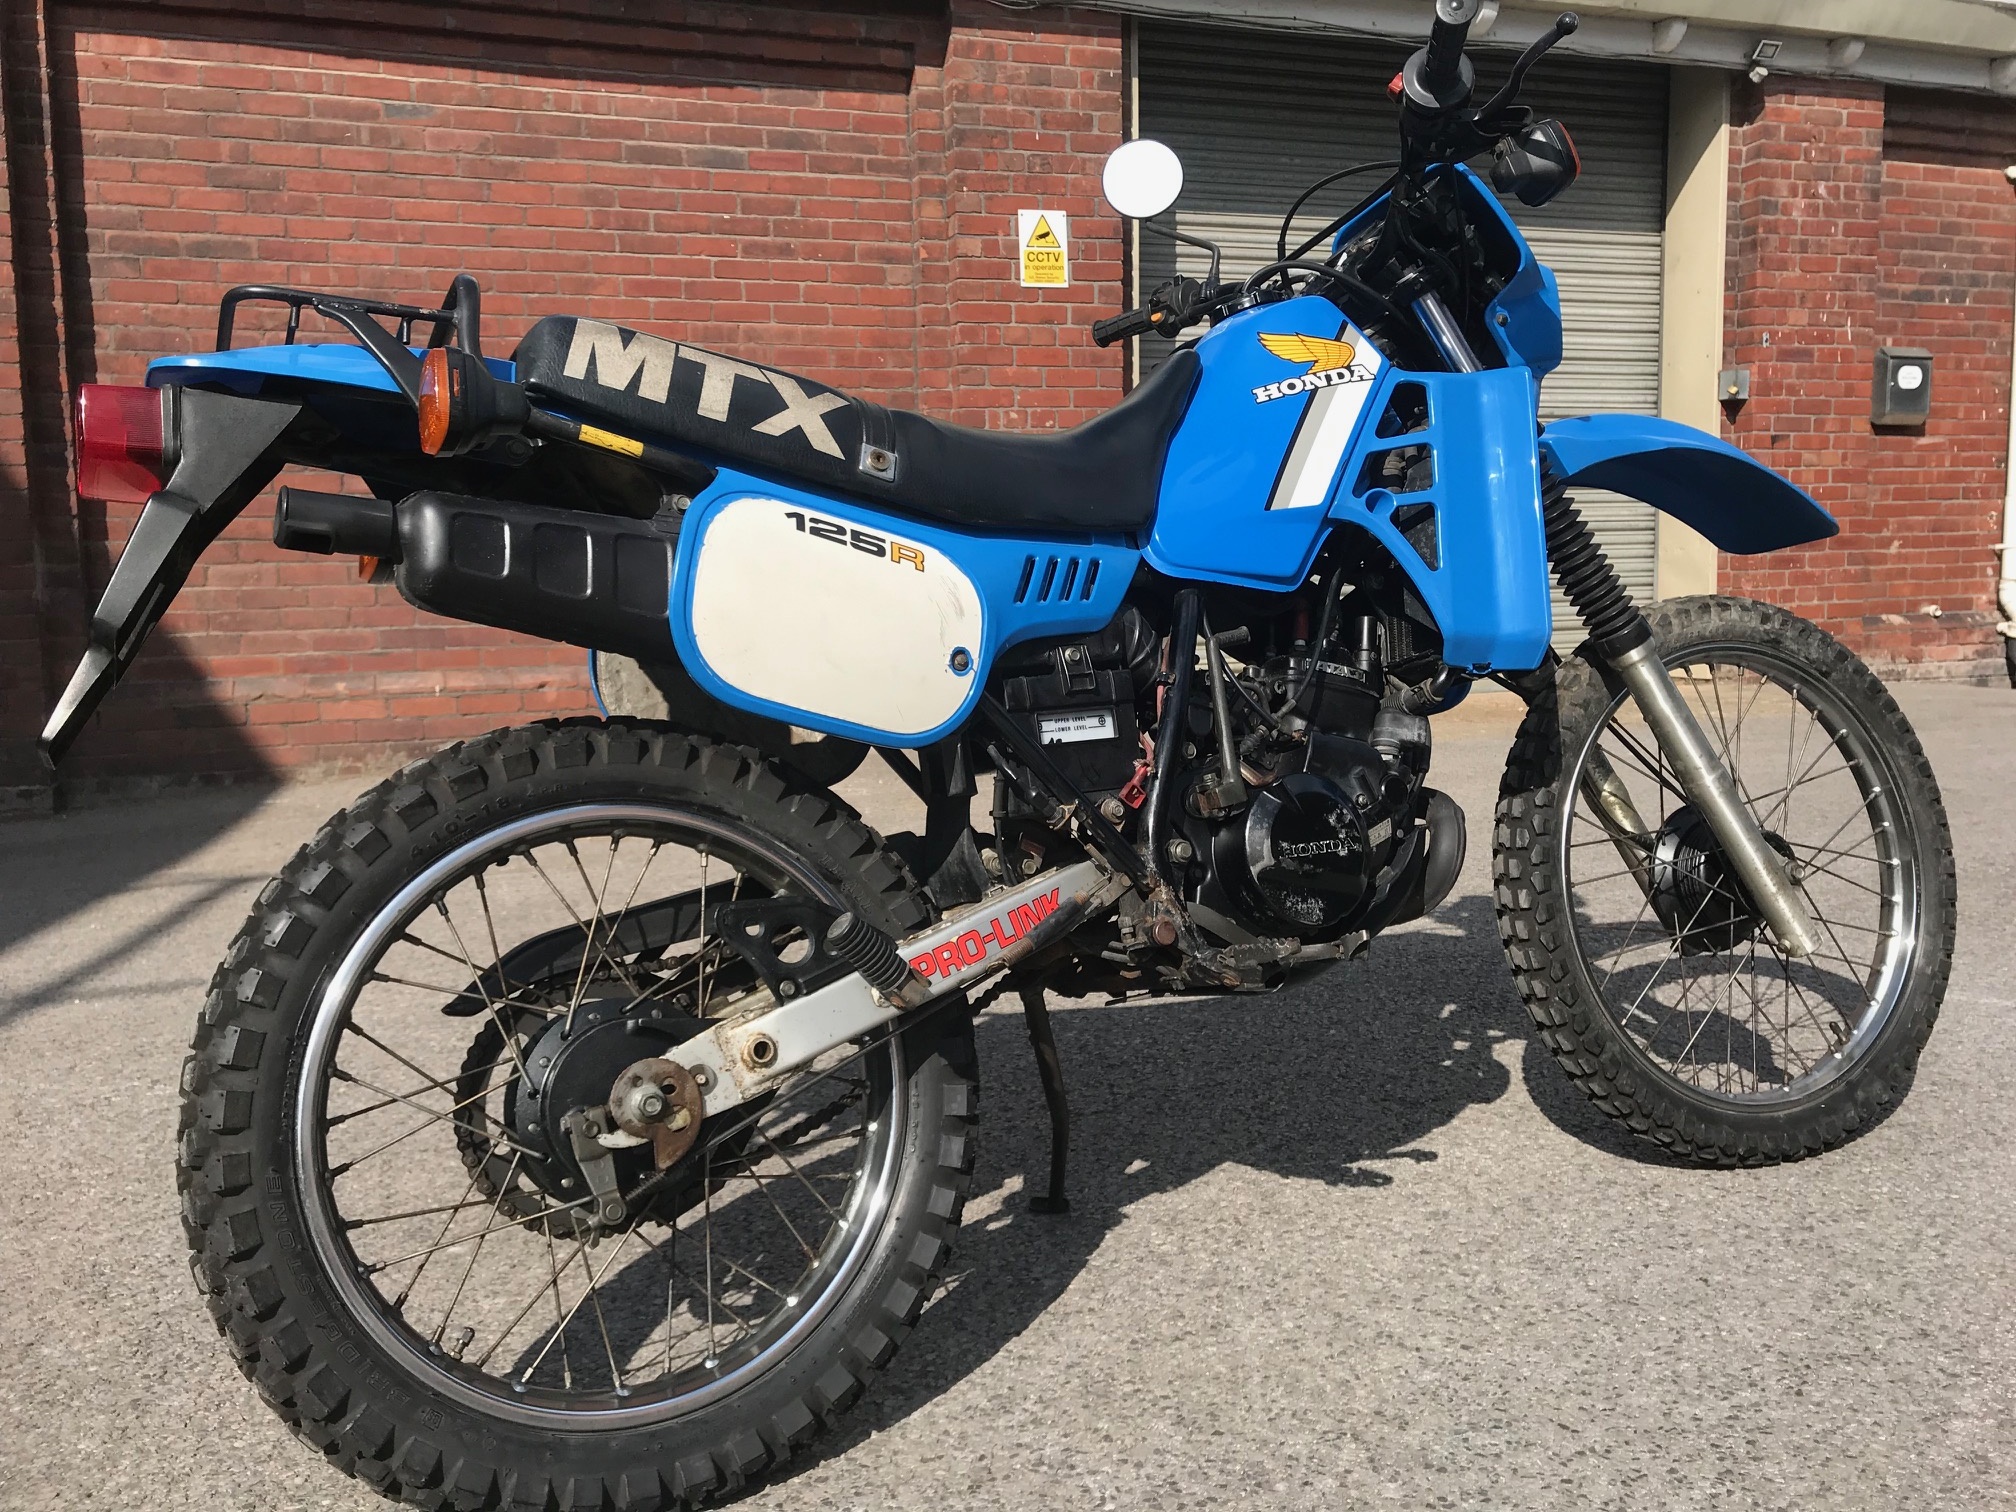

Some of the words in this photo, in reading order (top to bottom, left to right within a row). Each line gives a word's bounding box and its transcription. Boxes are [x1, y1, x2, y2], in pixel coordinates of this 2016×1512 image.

[1027, 251, 1061, 262] CCTV
[563, 318, 850, 461] MTX
[1252, 363, 1377, 404] HONDA
[784, 511, 925, 573] 125R
[1281, 838, 1357, 859] HONDA
[909, 887, 1060, 979] PRO-LINK
[264, 1173, 410, 1408] BRIDGESTONE
